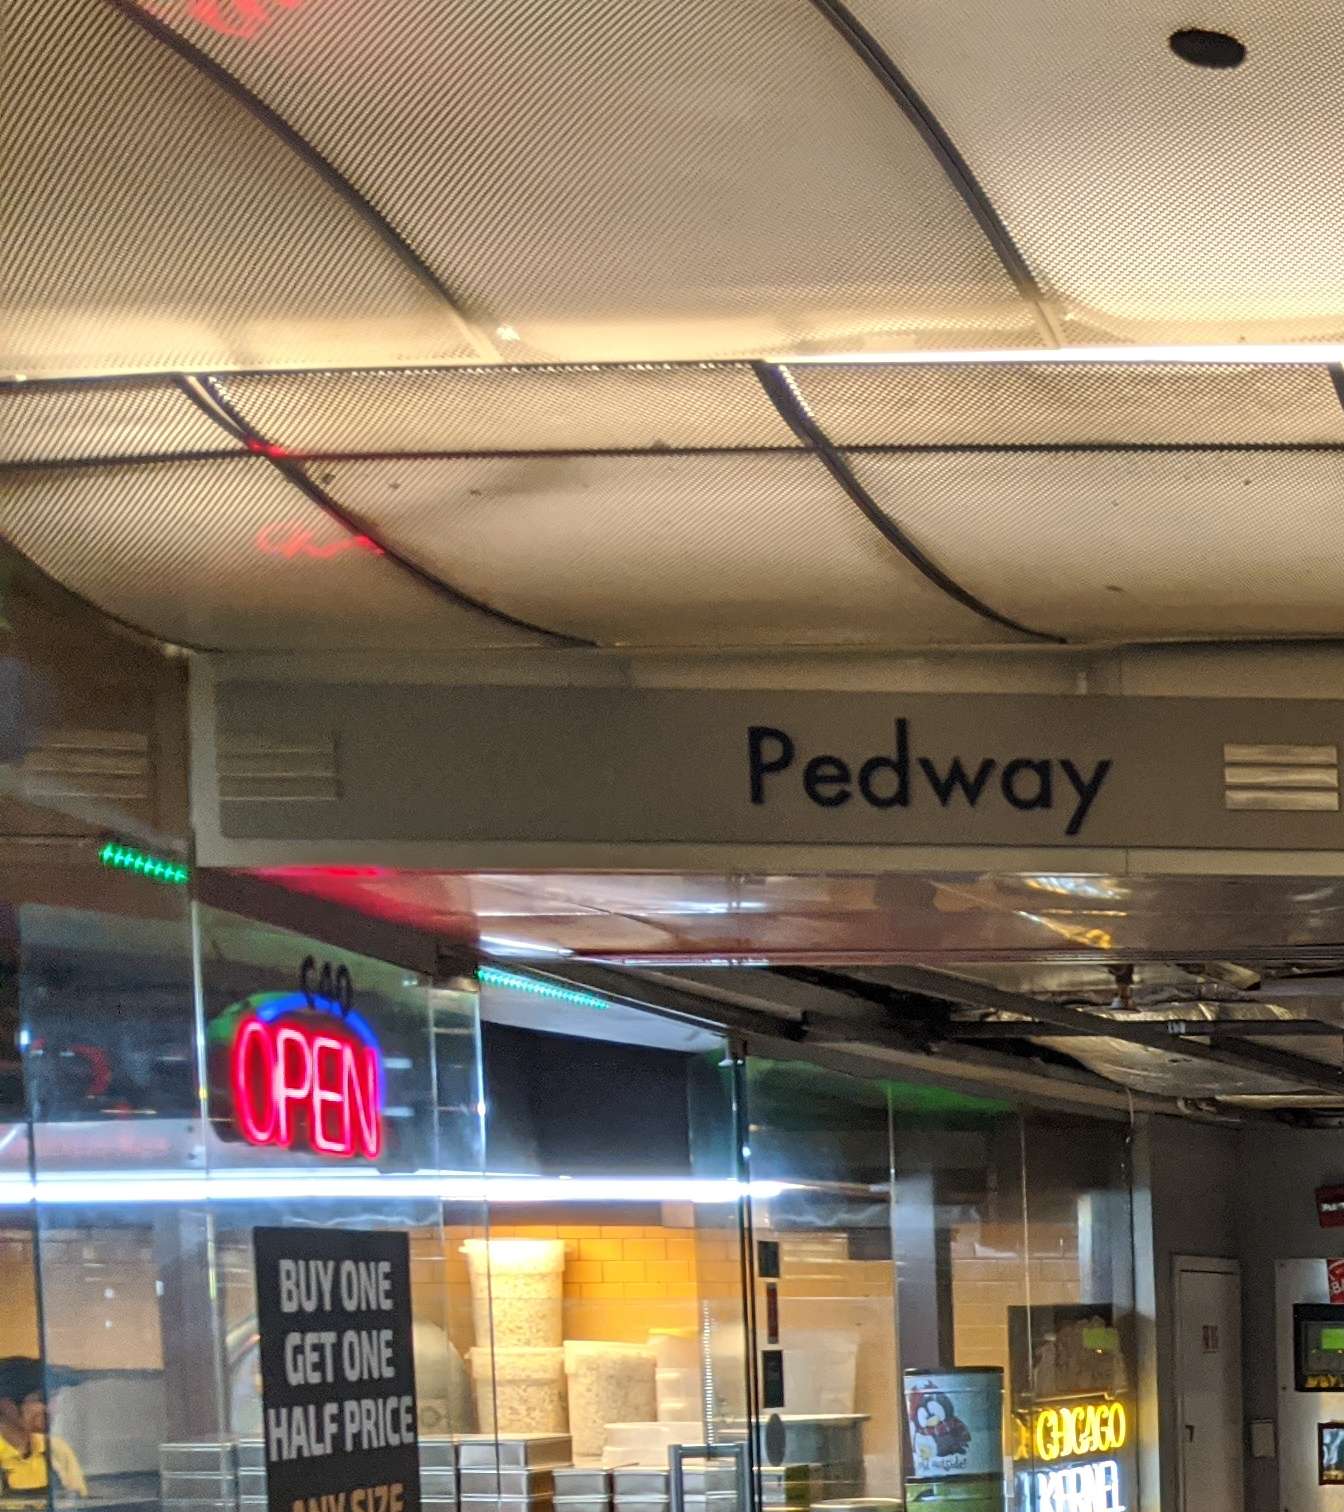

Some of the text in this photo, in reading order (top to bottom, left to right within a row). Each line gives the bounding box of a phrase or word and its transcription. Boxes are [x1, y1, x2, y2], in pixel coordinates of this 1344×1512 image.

[748, 717, 1113, 836] Pedway
[231, 1015, 382, 1159] OPEN
[279, 1259, 393, 1313] BUY ONE
[285, 1329, 395, 1386] GET ONE
[268, 1396, 414, 1462] HALF PRICE
[1037, 1402, 1126, 1461] CHICAGO
